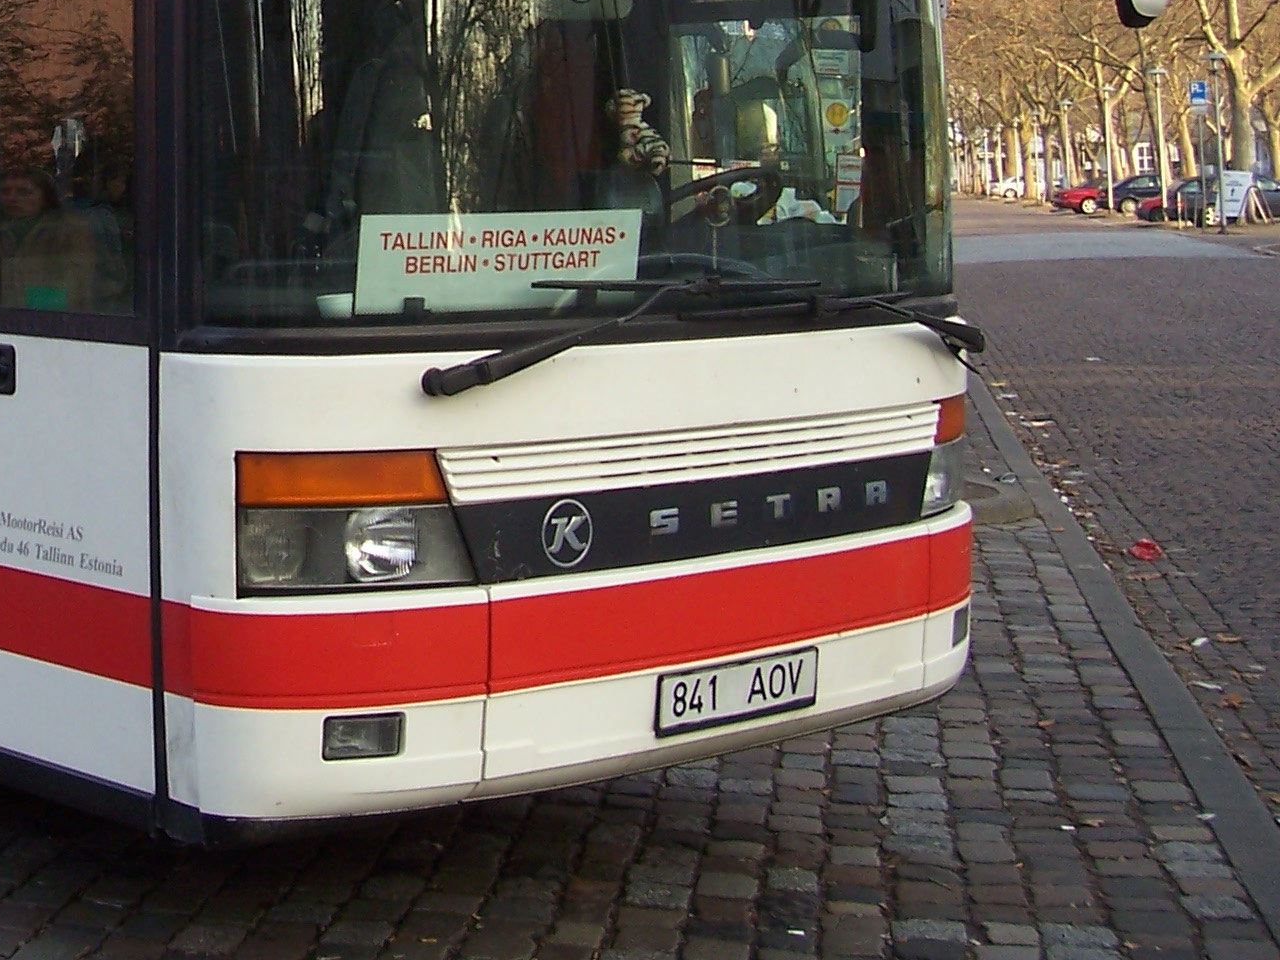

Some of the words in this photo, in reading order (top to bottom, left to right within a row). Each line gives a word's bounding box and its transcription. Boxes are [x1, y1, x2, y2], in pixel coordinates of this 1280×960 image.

[380, 230, 464, 252] TALLINN
[481, 229, 528, 249] RIGA
[543, 226, 616, 247] KAUNAS
[405, 254, 477, 275] BERLIN
[493, 250, 601, 272] STUTTGART
[649, 479, 888, 537] SETRA
[0, 511, 65, 539] MootorReisi
[65, 526, 84, 542] AS
[16, 540, 30, 557] 46
[35, 543, 75, 567] Tallinn
[79, 552, 124, 577] Estonia
[672, 674, 718, 718] 841
[747, 658, 804, 704] AOV
